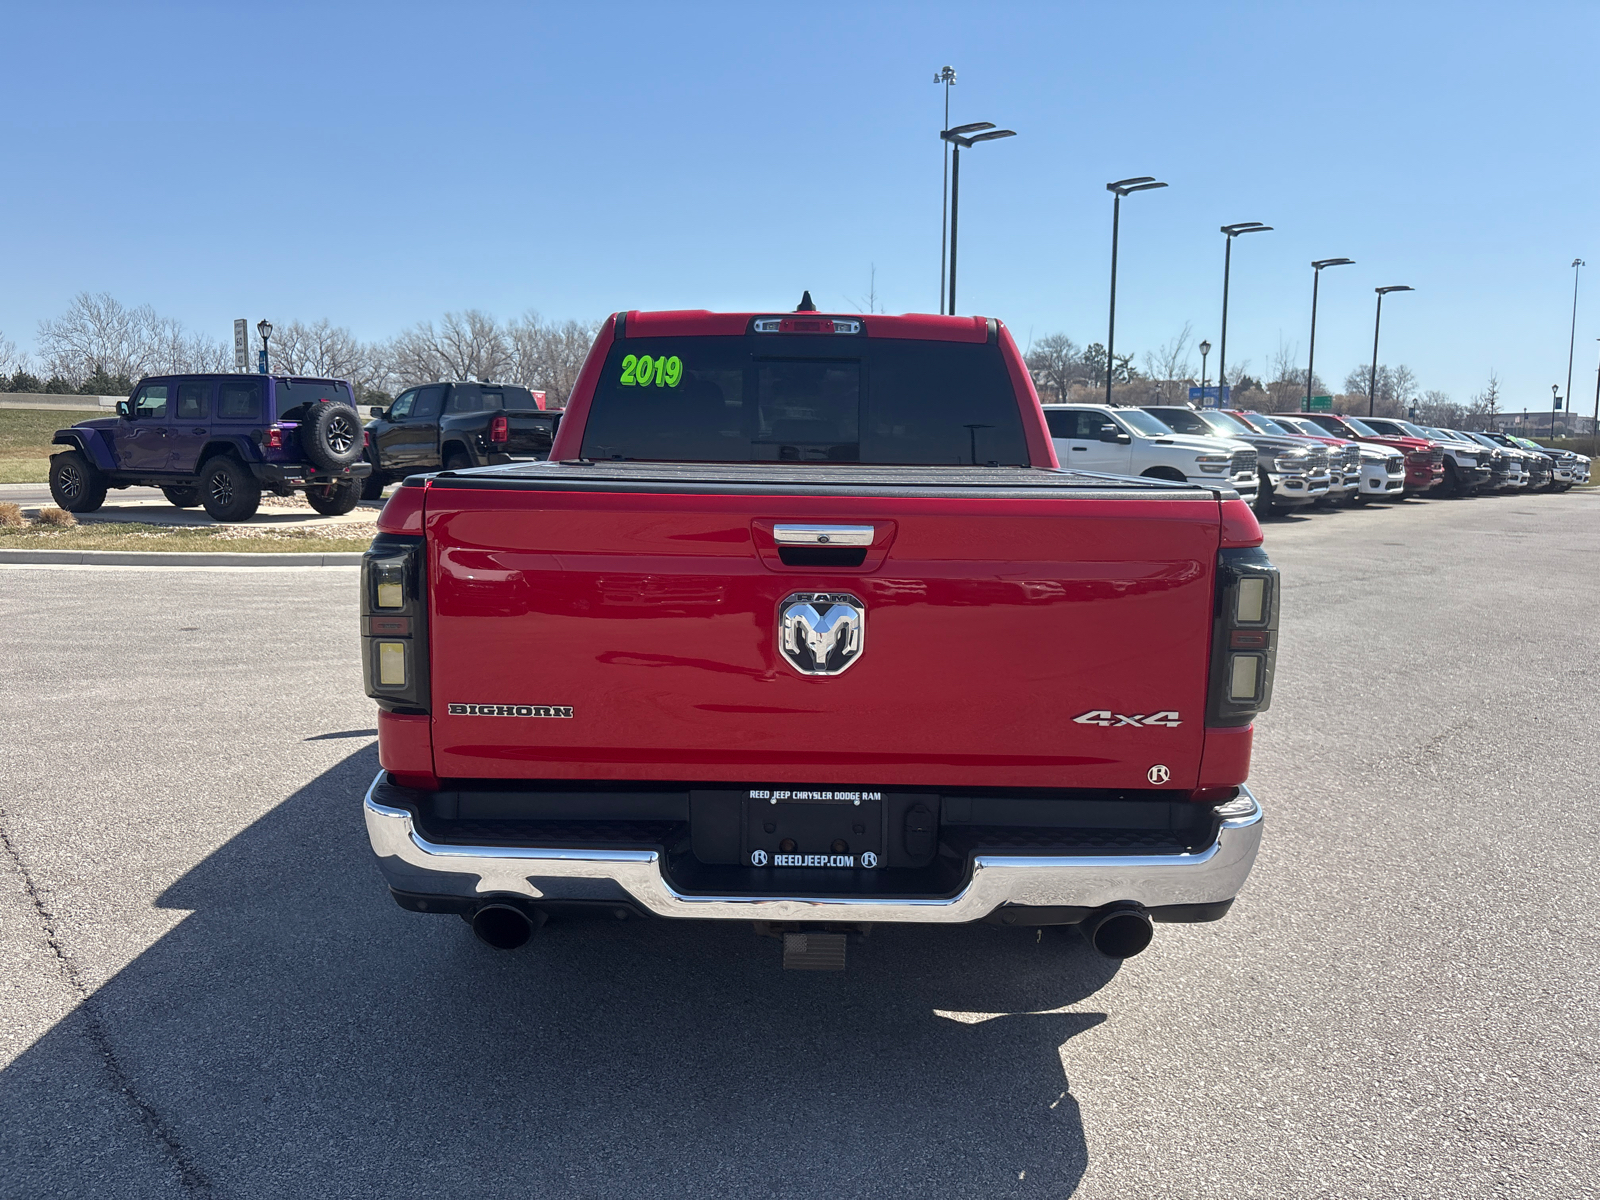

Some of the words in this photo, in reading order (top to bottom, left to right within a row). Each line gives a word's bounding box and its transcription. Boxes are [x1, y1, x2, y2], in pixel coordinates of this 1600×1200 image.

[620, 354, 683, 388] 2019
[796, 593, 849, 602] RAM
[448, 703, 574, 719] BIGHORN
[1072, 710, 1183, 727] 4x4
[750, 790, 770, 799] REED
[772, 790, 791, 800] JEEP
[792, 791, 833, 800] CHRYSLER
[834, 791, 861, 801] DODGE
[862, 792, 881, 801] RAM
[774, 855, 854, 867] REEDJEEP.COM
